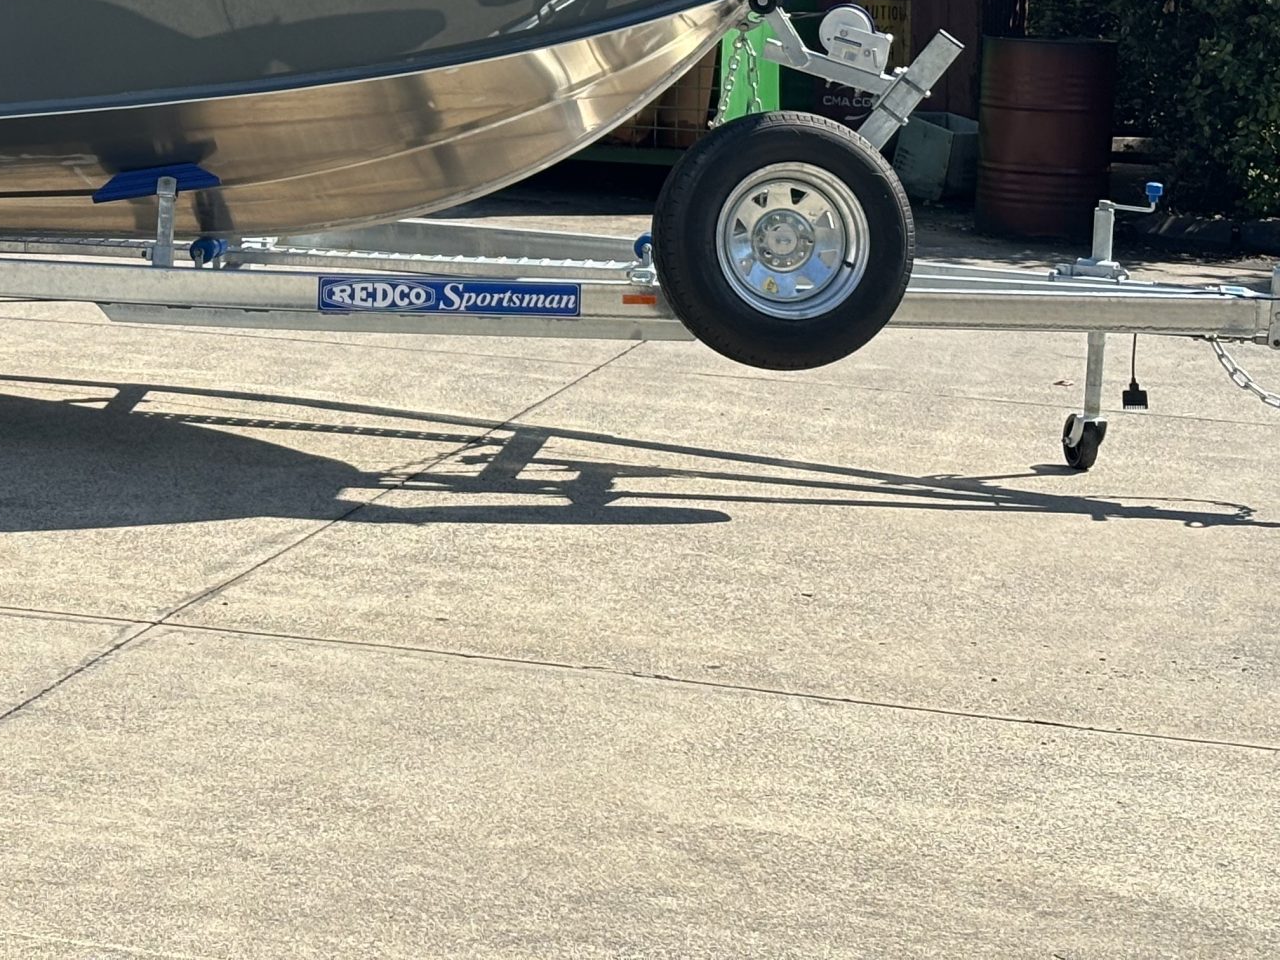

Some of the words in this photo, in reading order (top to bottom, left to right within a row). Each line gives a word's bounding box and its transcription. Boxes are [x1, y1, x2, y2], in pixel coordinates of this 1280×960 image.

[864, 4, 907, 21] AUTION
[822, 95, 851, 107] CMA
[852, 97, 872, 108] CG
[439, 282, 577, 311] Sportsman
